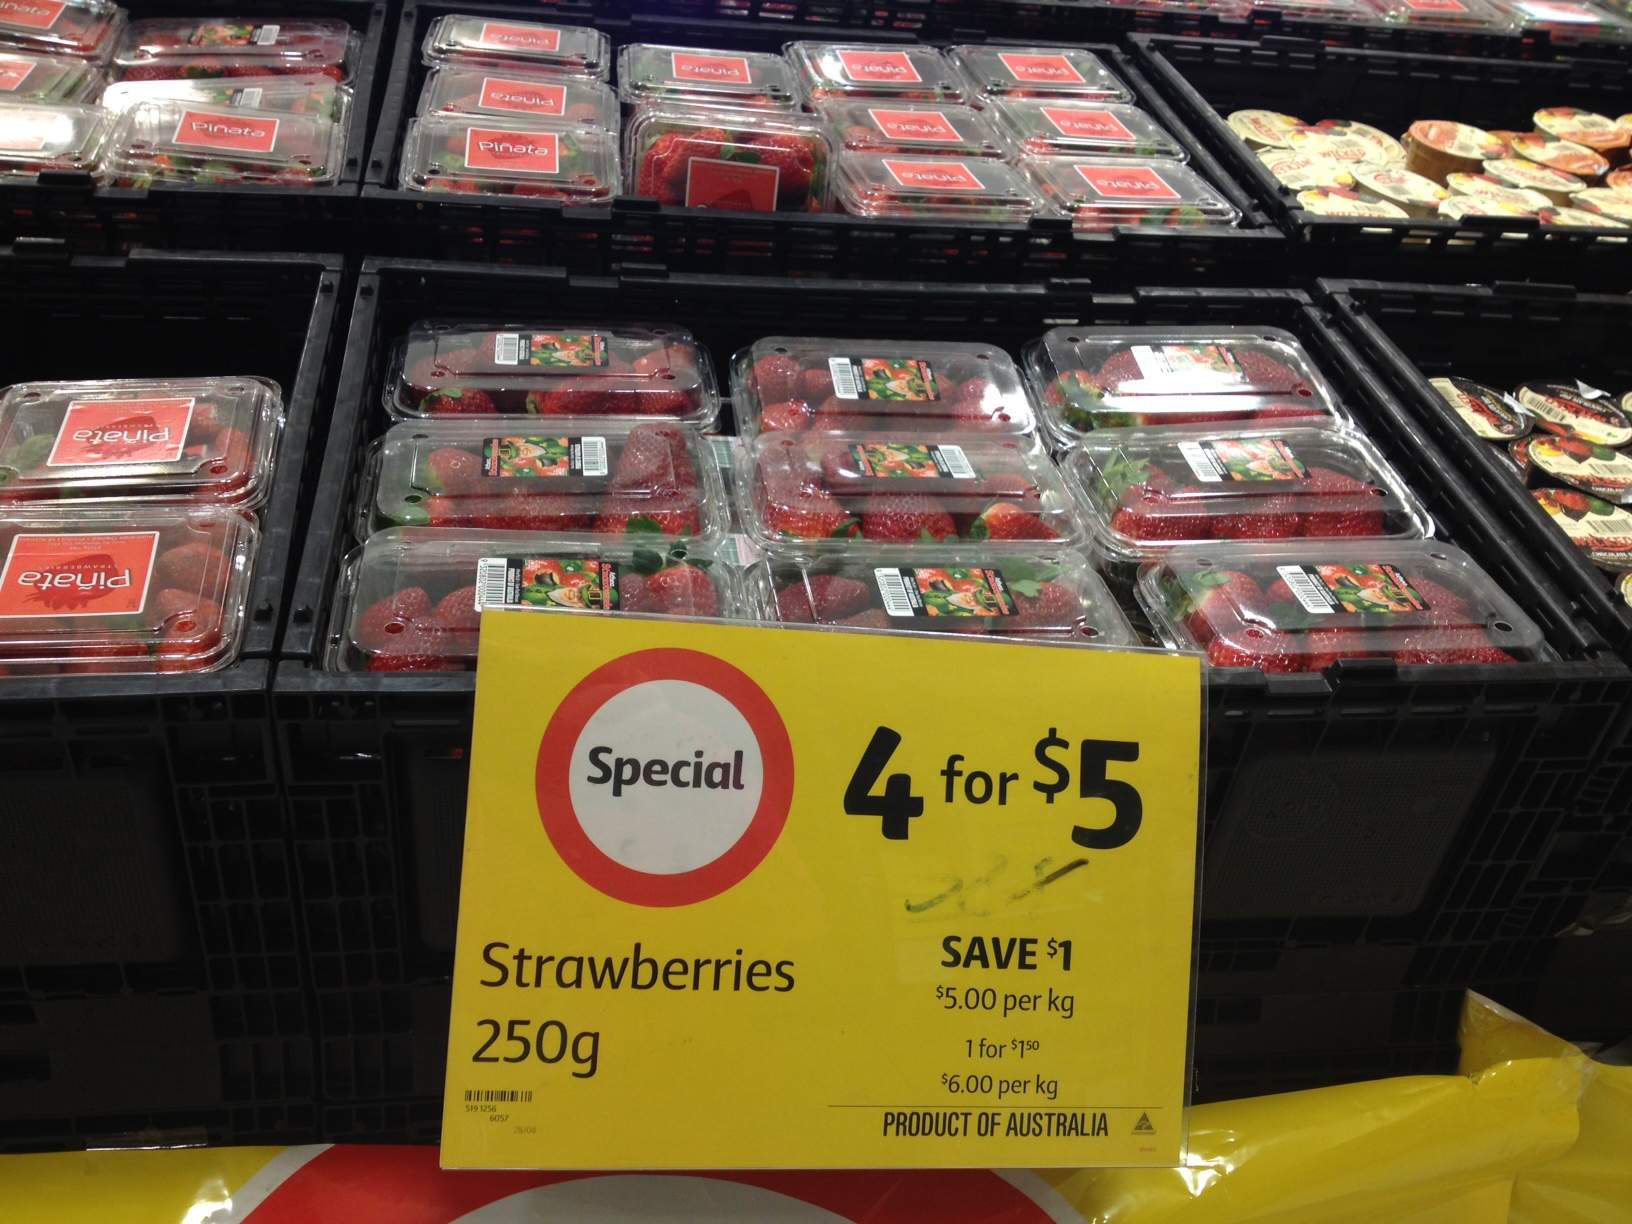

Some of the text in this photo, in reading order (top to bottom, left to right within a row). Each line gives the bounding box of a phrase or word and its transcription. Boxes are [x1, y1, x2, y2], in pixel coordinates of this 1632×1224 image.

[587, 746, 745, 797] Special
[843, 725, 1144, 851] 4 for $5
[479, 941, 795, 993] Strawberries
[940, 935, 1073, 972] SAVE $1
[935, 984, 1075, 1019] $5.00 per kg
[471, 1018, 600, 1079] 250g
[965, 1039, 973, 1058] 1
[979, 1037, 1007, 1059] for
[941, 1072, 1059, 1101] $6.00 per kg
[882, 1110, 1110, 1138] PRODUCT OF AUSTRALIA
